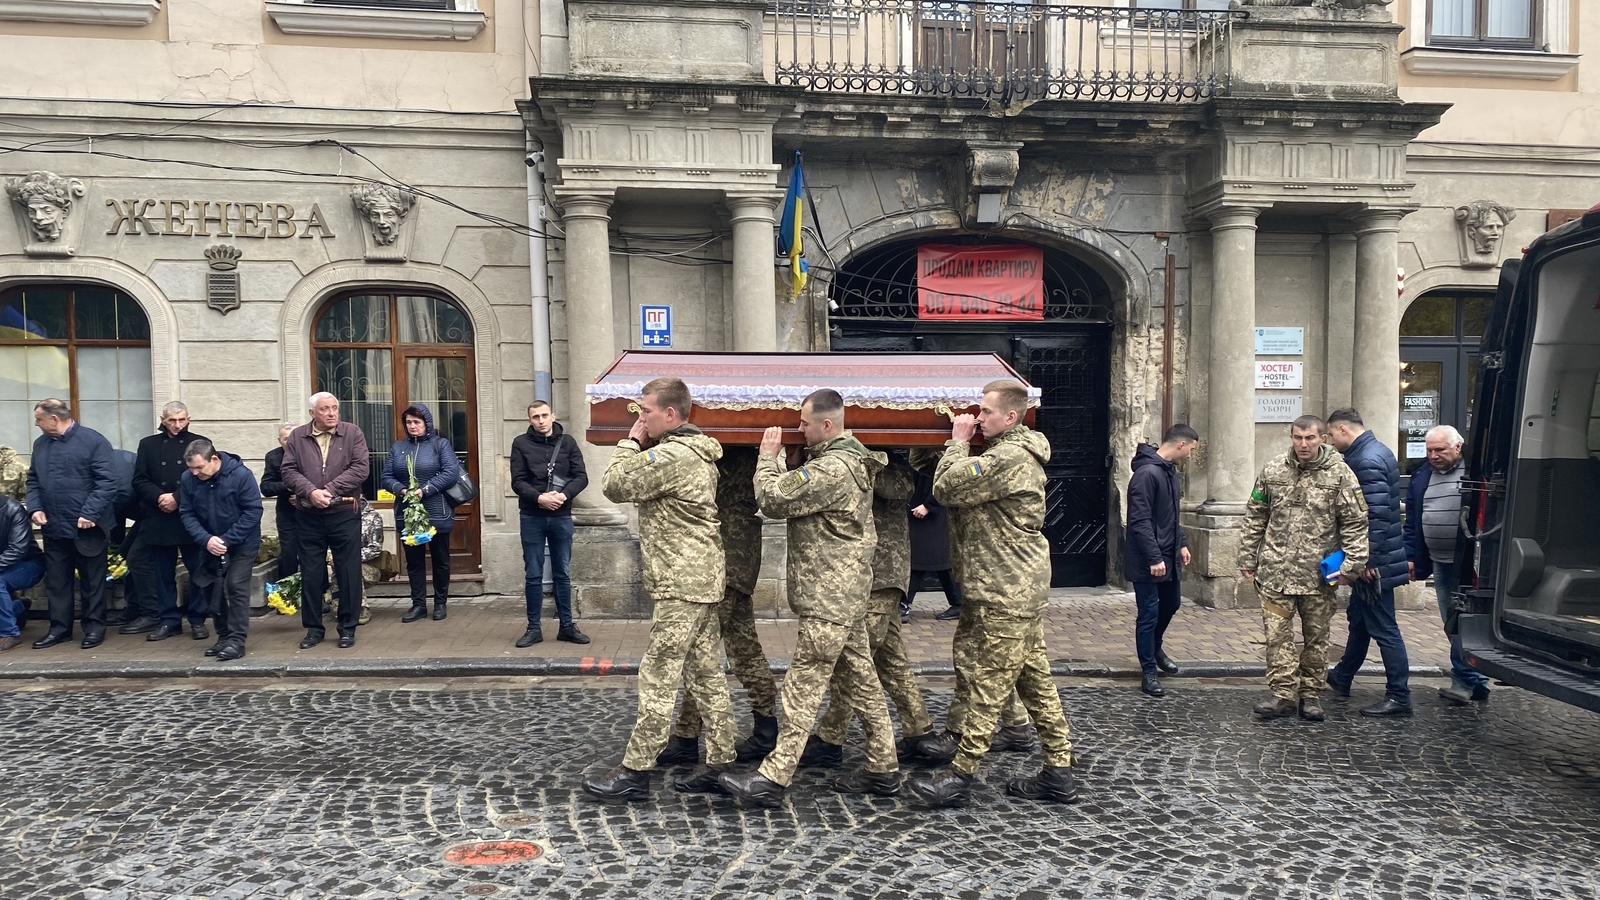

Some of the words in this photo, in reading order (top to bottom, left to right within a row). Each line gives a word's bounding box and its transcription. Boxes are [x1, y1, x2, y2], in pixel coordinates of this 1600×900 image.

[105, 198, 336, 239] ЖЕНЕВА
[923, 259, 974, 279] ПРОДАМ
[977, 259, 1038, 278] КВАРТИРУ
[925, 293, 955, 314] 067
[959, 293, 989, 314] 840
[1017, 293, 1036, 314] 44
[648, 312, 664, 322] ПГ
[1262, 405, 1291, 413] УБОРИ
[1404, 398, 1432, 406] FASHION
